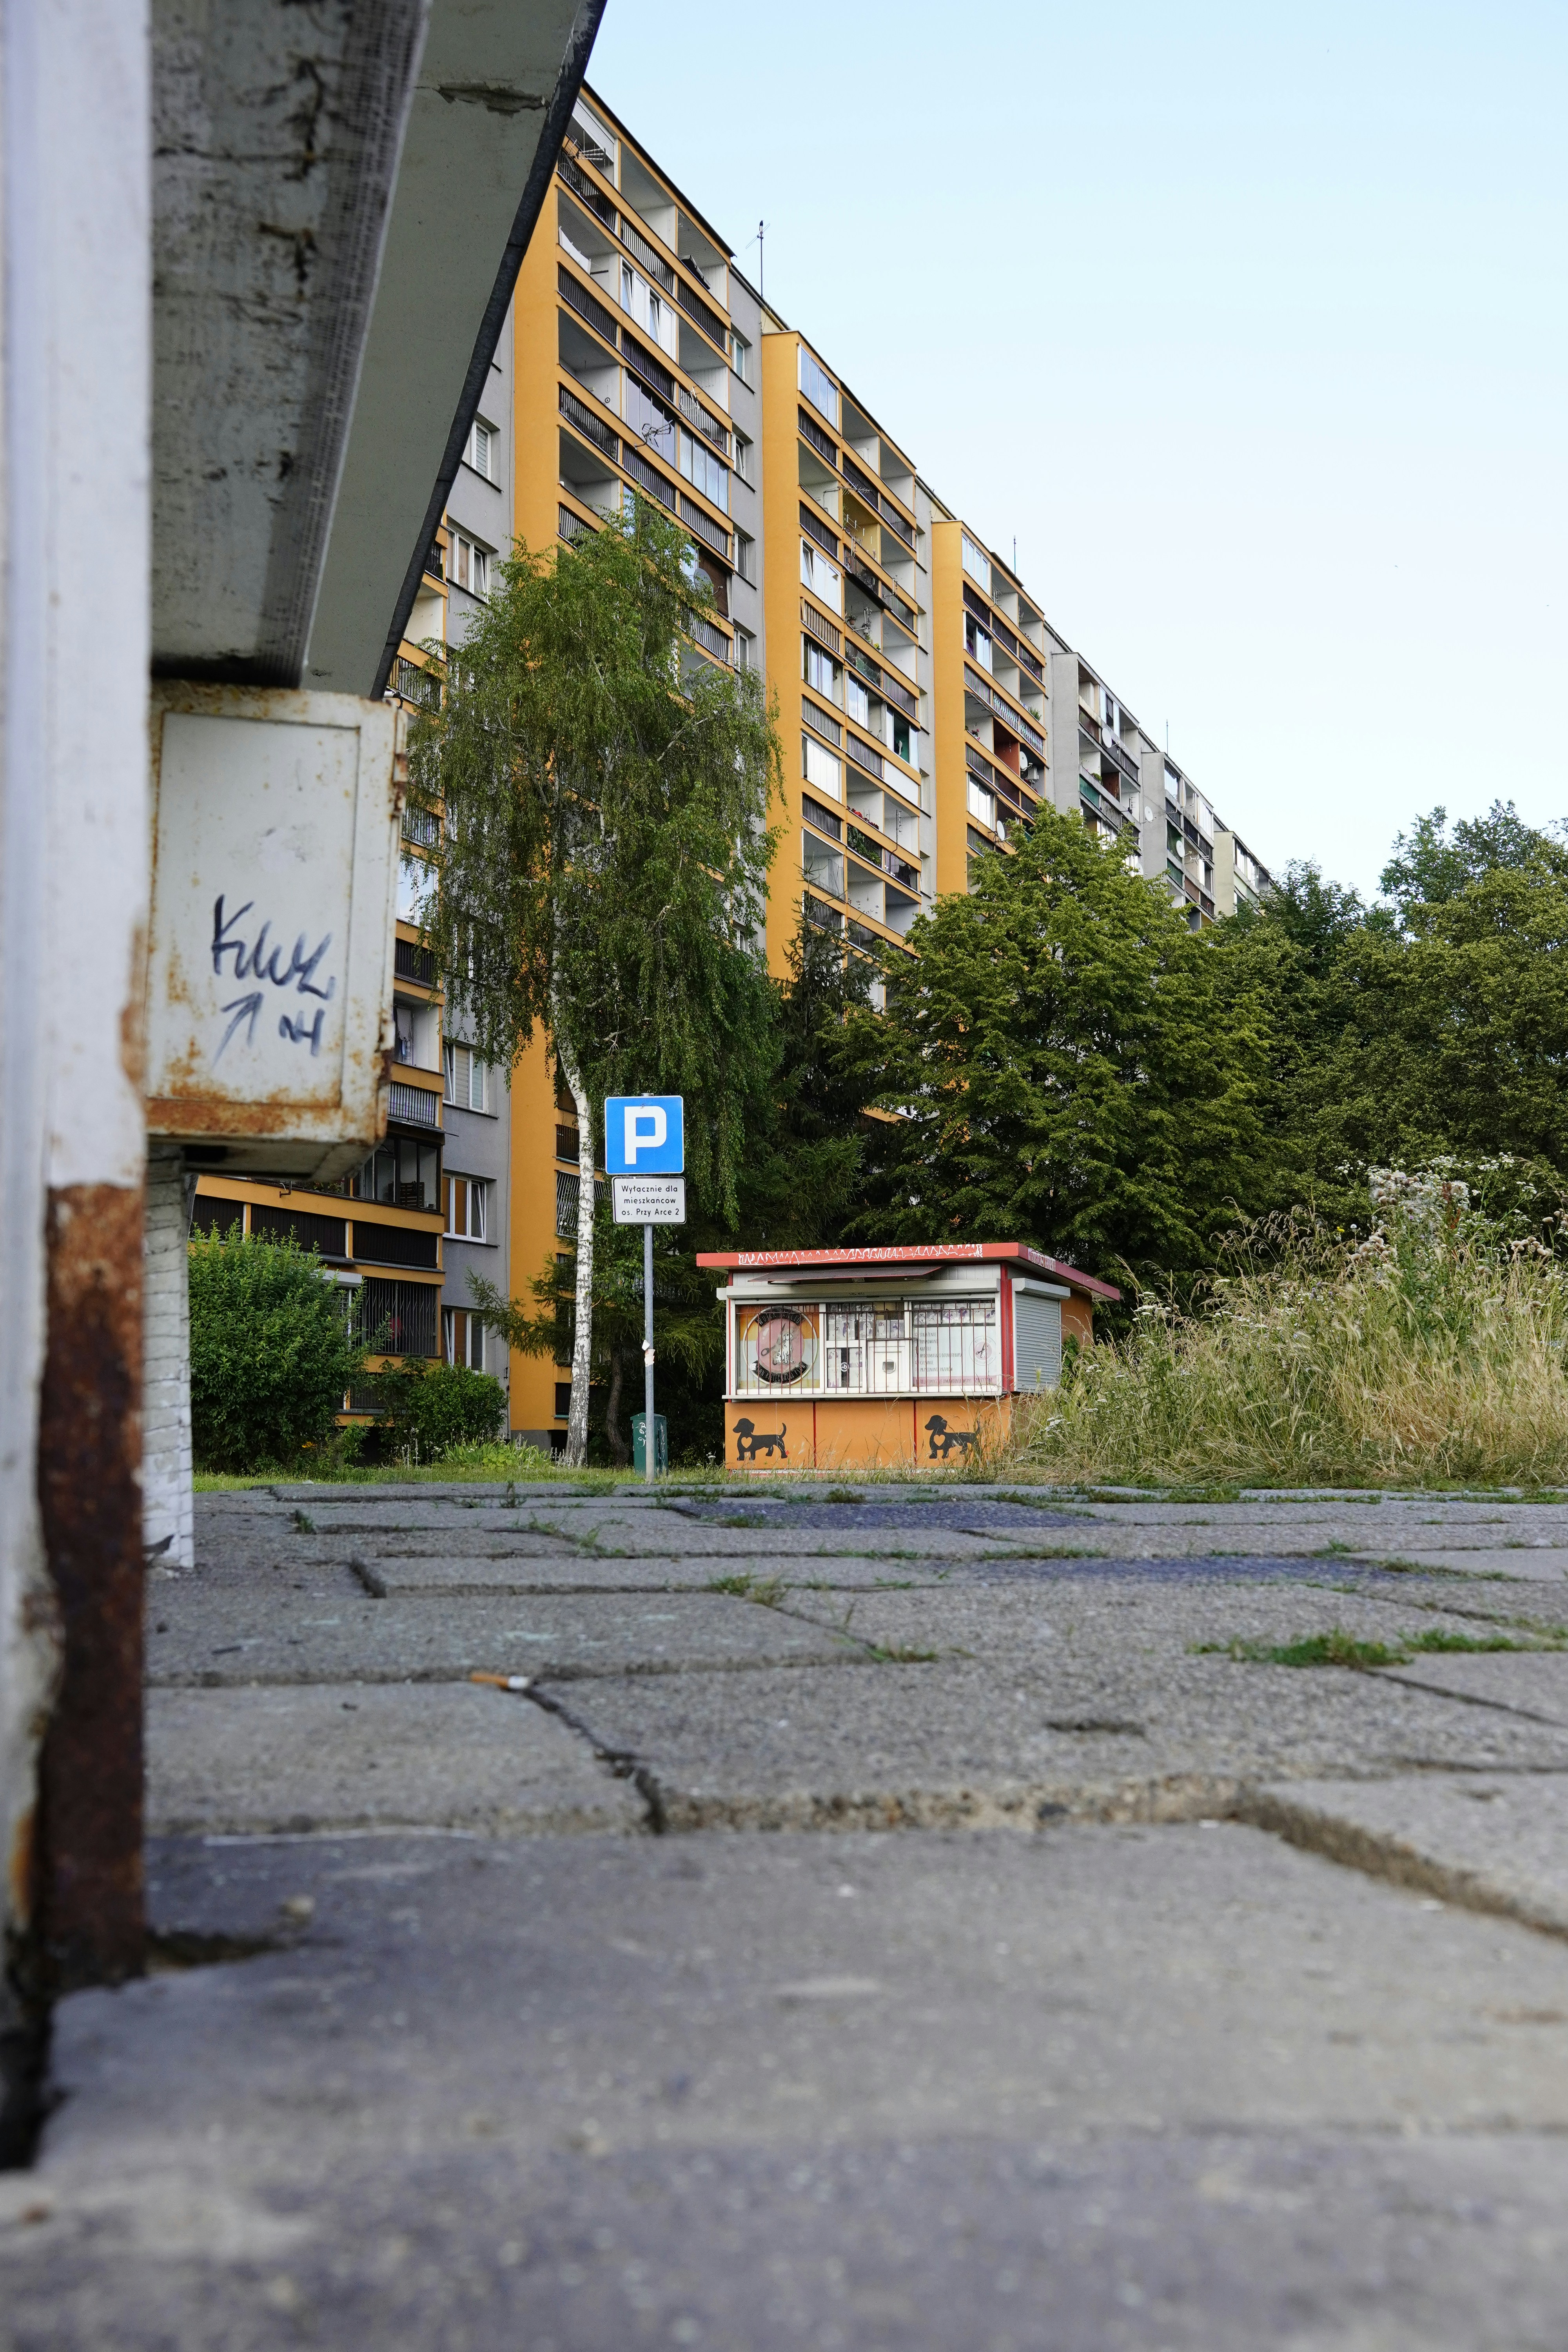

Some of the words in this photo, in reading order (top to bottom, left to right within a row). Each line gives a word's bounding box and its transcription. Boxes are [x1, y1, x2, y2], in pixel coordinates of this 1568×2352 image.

[624, 1106, 667, 1165] P
[621, 1185, 662, 1194] Wyłącznie
[636, 1208, 651, 1217] Przy
